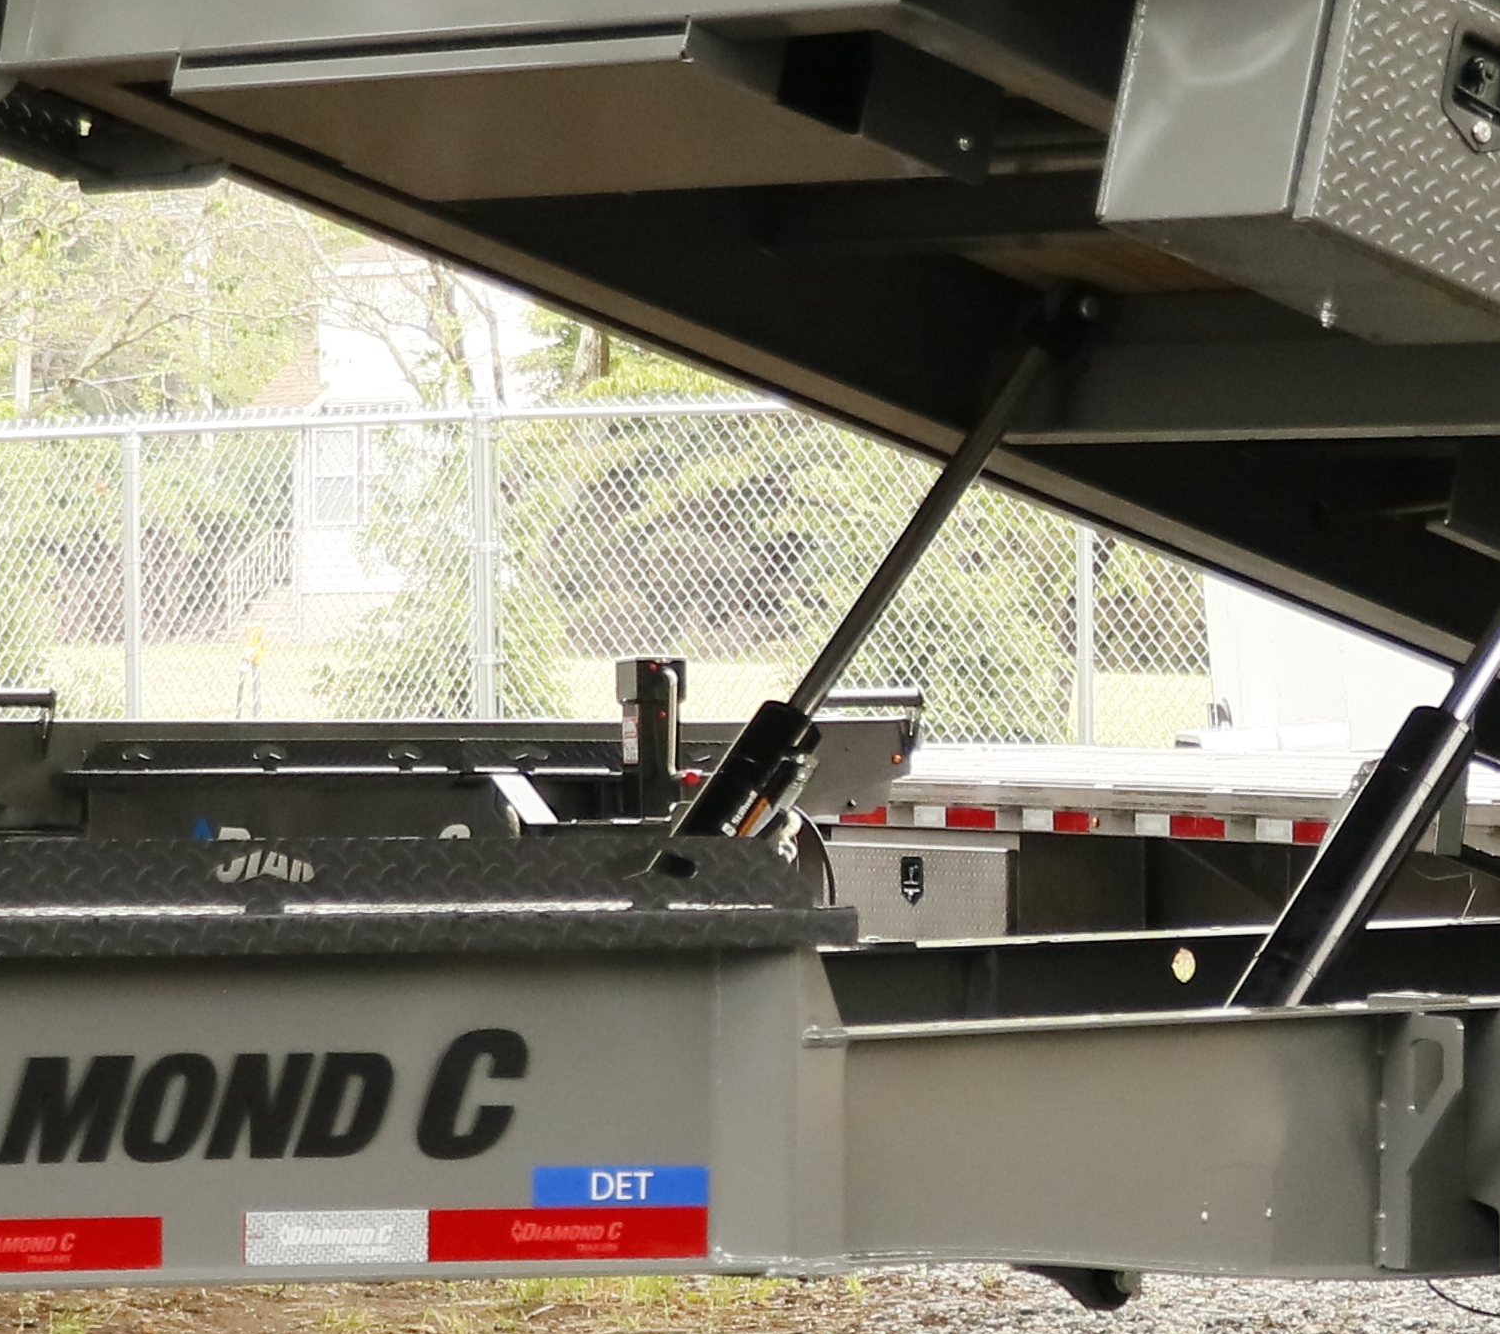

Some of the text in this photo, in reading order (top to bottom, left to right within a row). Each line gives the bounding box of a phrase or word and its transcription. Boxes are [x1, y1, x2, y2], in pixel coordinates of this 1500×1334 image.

[415, 1027, 530, 1162] C
[590, 1171, 655, 1201] DET
[59, 1232, 76, 1252] C
[520, 1221, 623, 1242] DIAMOND C
